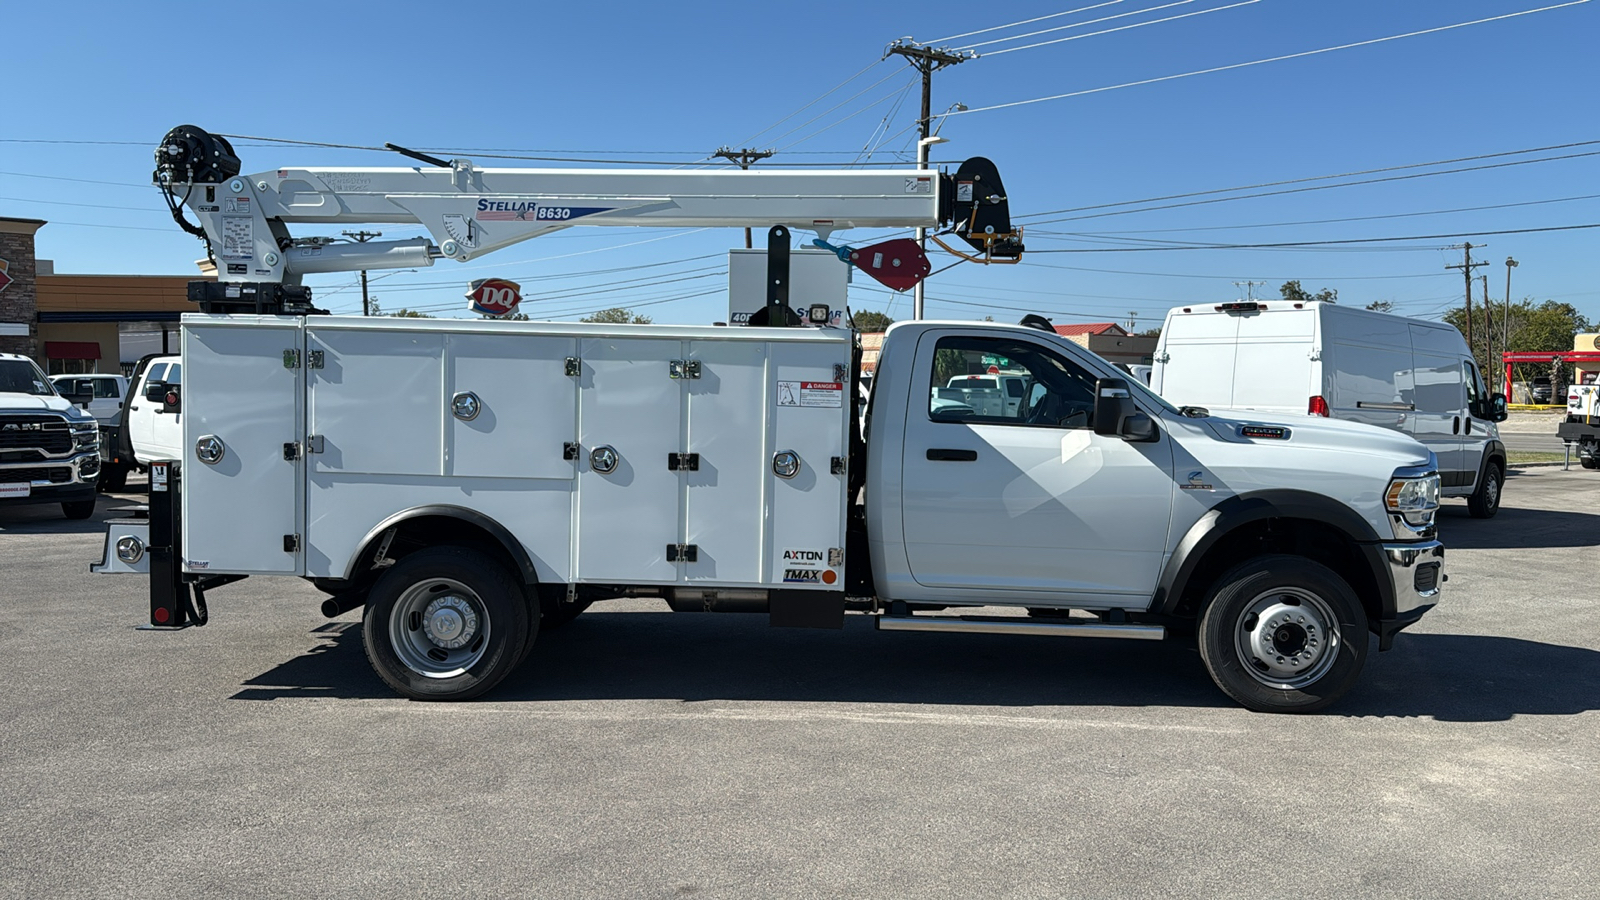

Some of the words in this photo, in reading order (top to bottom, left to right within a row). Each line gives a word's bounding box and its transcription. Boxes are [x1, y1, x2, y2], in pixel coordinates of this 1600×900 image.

[477, 199, 537, 212] STELLAR
[538, 207, 571, 219] 8630
[480, 286, 515, 309] DQ
[796, 308, 842, 318] STAR
[1, 423, 41, 431] AM
[783, 550, 823, 561] AXTON
[785, 569, 819, 580] TMAX
